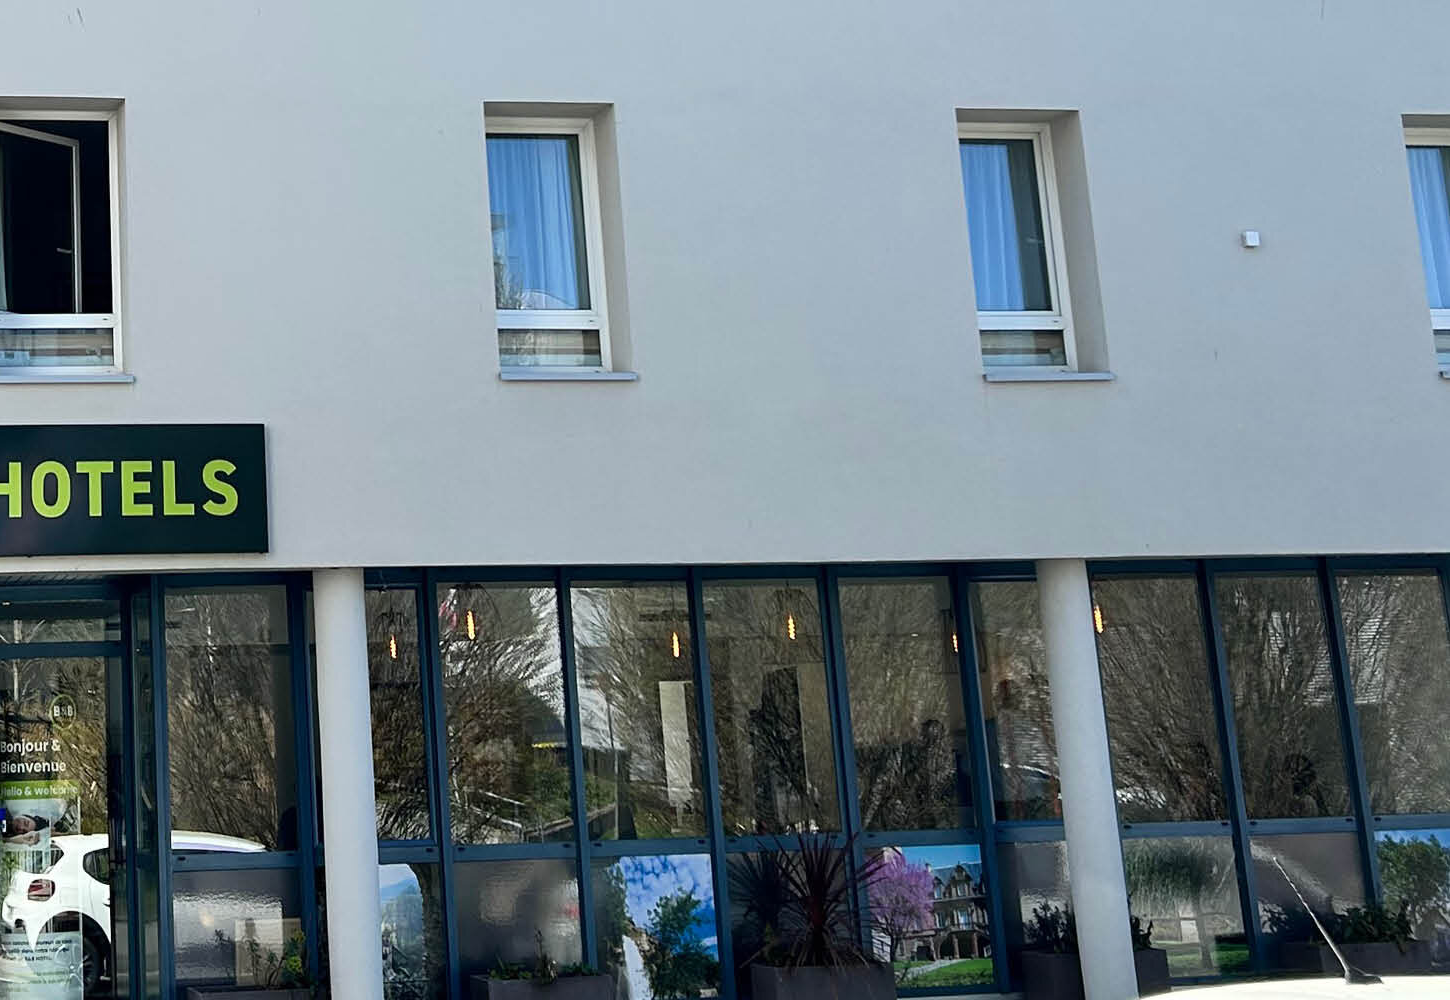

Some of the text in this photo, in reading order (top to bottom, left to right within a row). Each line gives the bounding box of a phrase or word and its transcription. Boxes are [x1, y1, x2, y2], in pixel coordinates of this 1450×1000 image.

[0, 738, 62, 757] Bonjour &
[0, 760, 67, 774] Bienvenue
